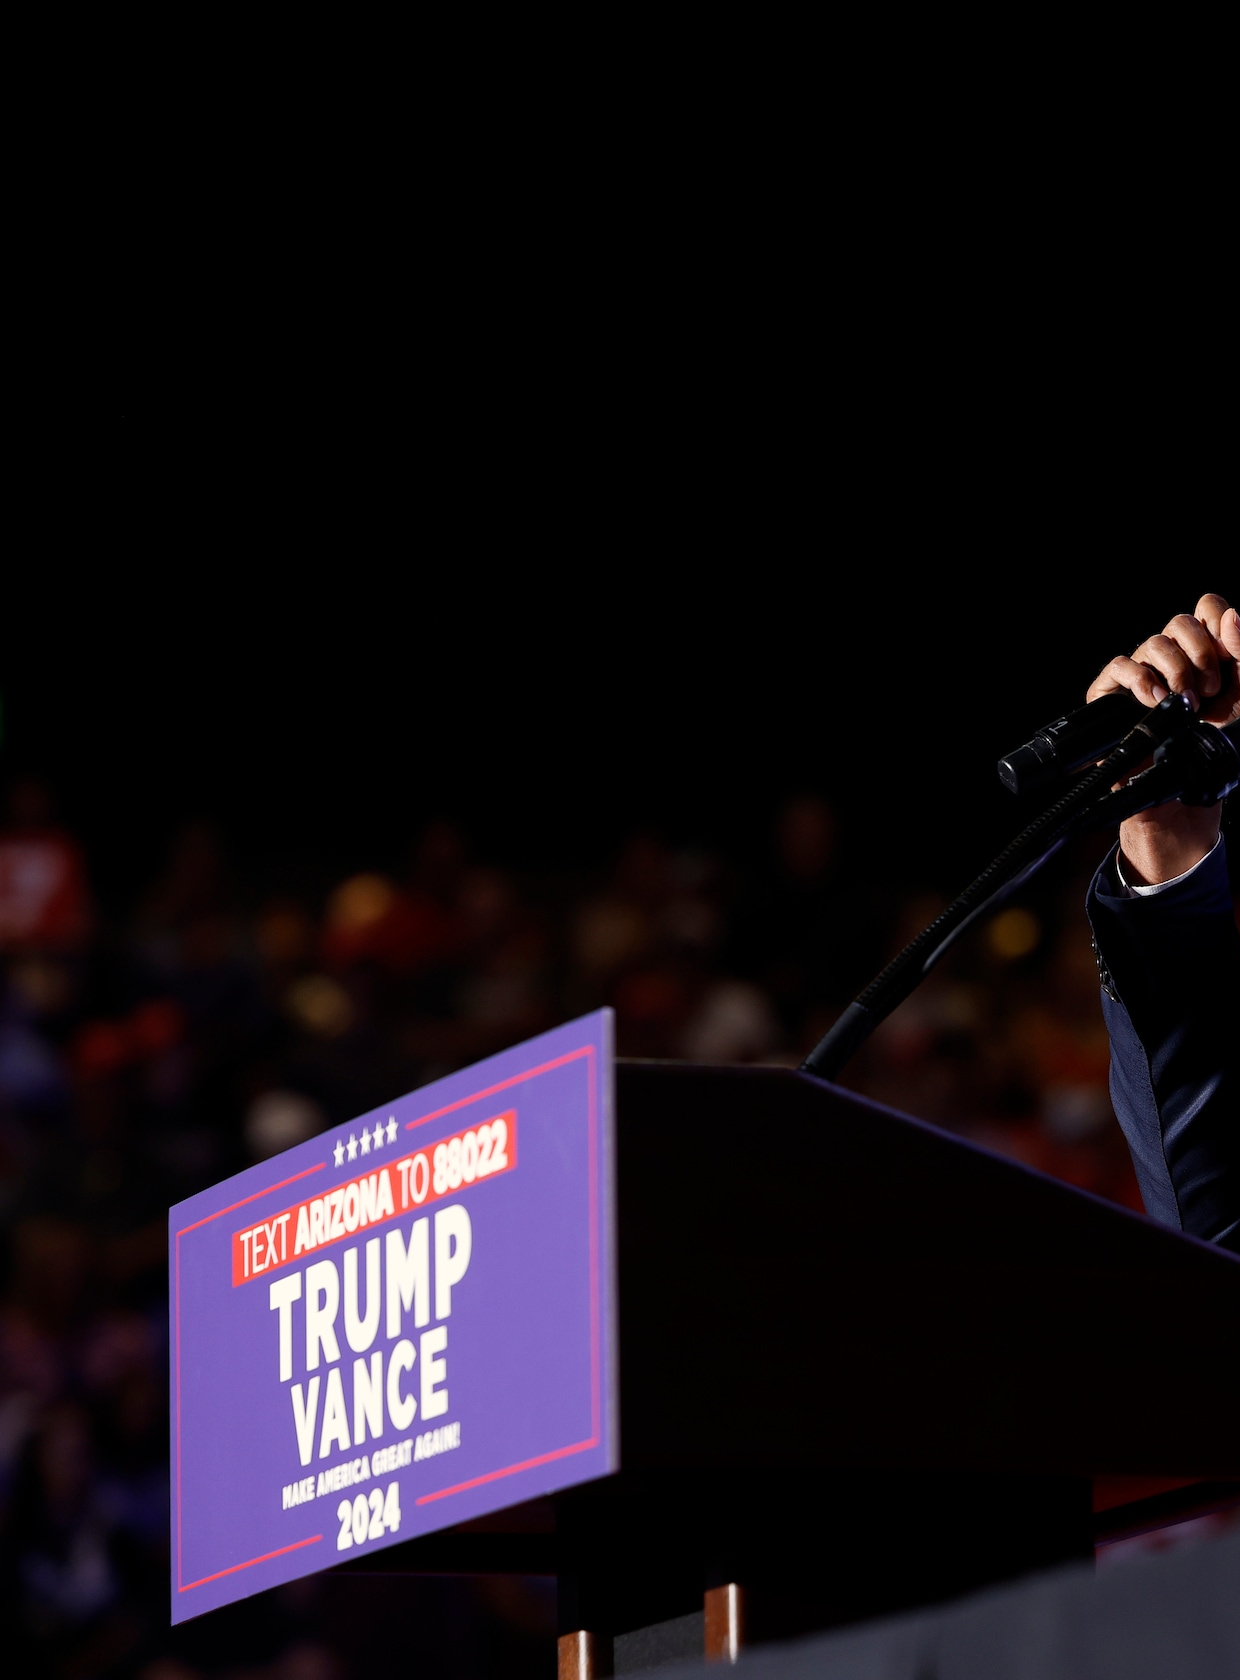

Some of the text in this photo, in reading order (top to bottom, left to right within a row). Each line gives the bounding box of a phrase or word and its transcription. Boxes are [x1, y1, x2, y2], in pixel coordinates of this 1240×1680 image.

[239, 1118, 509, 1278] TEXT ARIZONA TO 88022
[269, 1203, 473, 1383] TRUMP
[282, 1421, 461, 1511] MAKE AMERICA GREAT AGAIN!
[291, 1325, 449, 1467] VANCE
[336, 1480, 402, 1551] 2024
